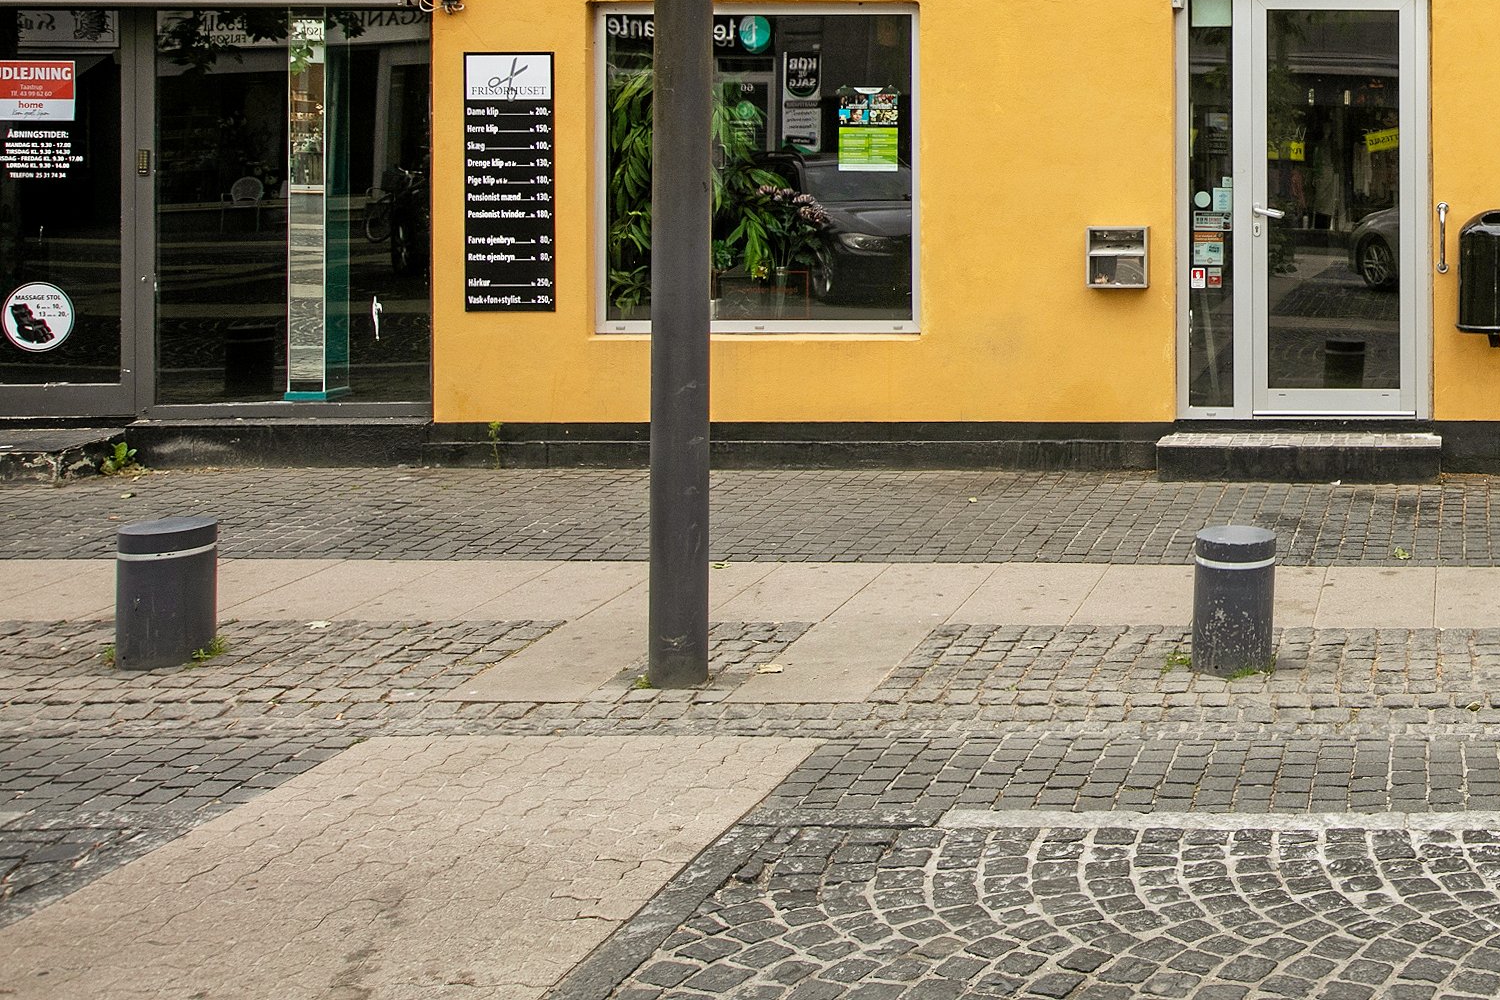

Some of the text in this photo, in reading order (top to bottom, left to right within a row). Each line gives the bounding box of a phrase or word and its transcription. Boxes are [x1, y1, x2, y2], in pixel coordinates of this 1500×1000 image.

[0, 67, 72, 80] DLEJNING
[467, 107, 486, 116] Dame
[486, 107, 499, 117] klip
[7, 128, 69, 138] ÅBNINGSTIDER:
[486, 124, 498, 134] klip
[467, 142, 486, 151] Skæg
[468, 159, 490, 168] Drenge
[492, 158, 504, 168] klip
[468, 176, 482, 186] Pige
[483, 176, 495, 186] klip
[468, 193, 500, 201] Pensionist
[468, 210, 500, 218] Pensionist
[501, 210, 526, 218] kvinder
[468, 236, 486, 244] Farve
[468, 253, 486, 261] Rette
